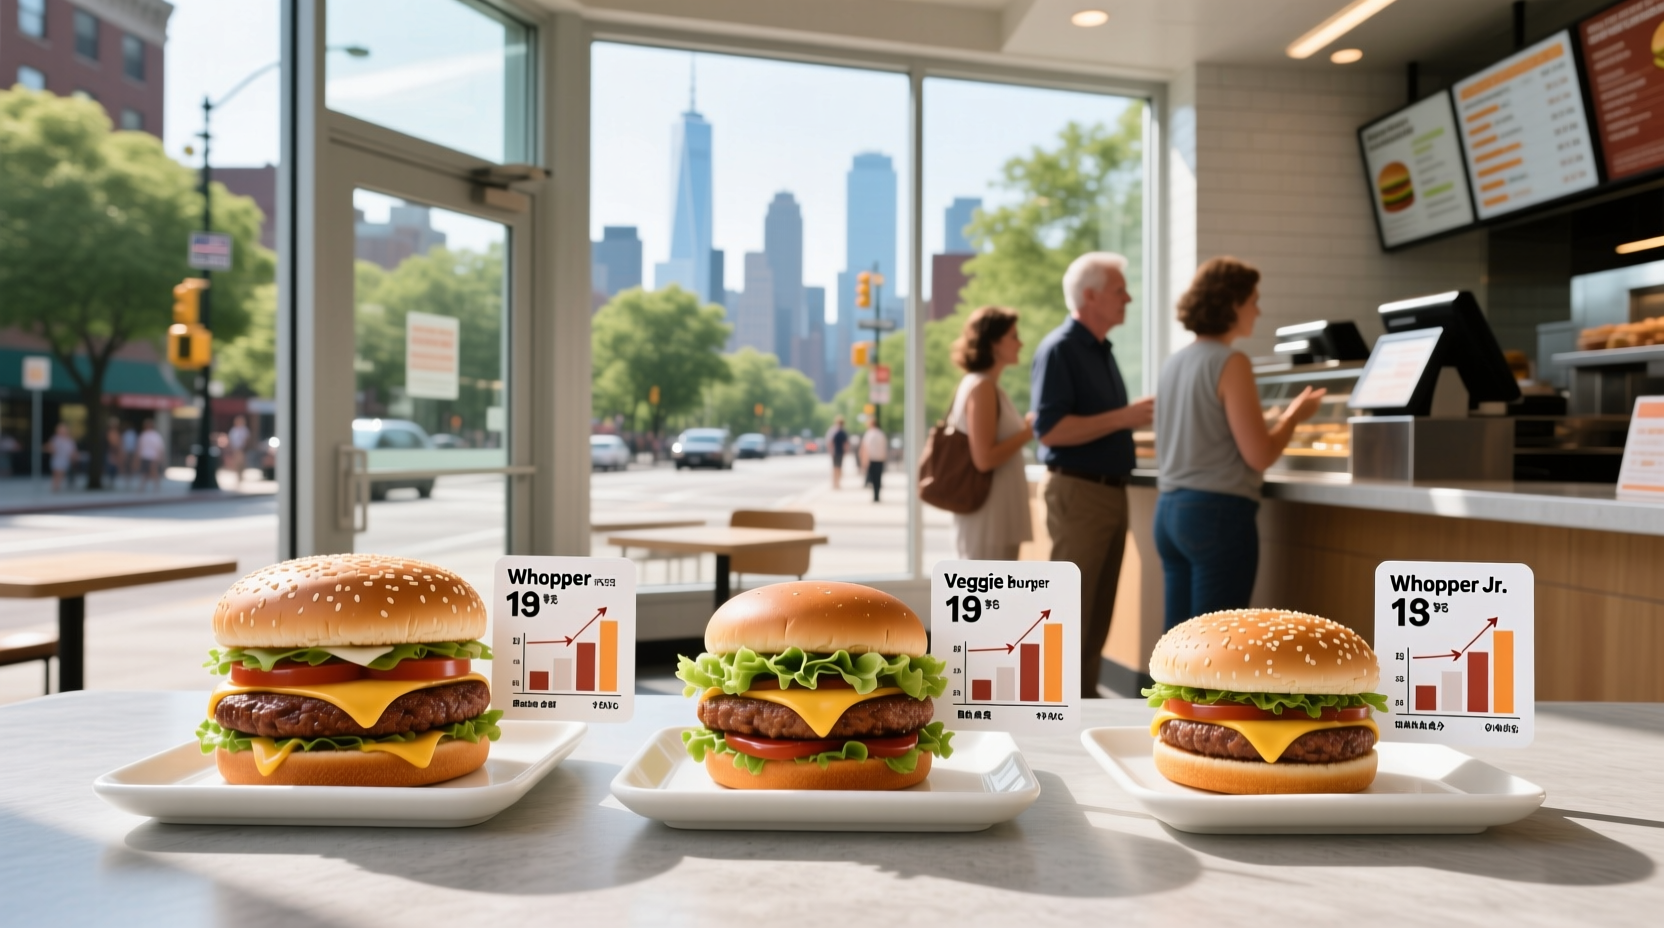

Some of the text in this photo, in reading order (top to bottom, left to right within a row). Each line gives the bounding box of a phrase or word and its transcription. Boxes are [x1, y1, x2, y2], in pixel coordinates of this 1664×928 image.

[508, 568, 592, 590] Whopper
[944, 573, 1004, 593] Veggie
[1390, 574, 1508, 596] Whopper Jr.
[506, 591, 540, 618] 19
[946, 595, 982, 623] 19
